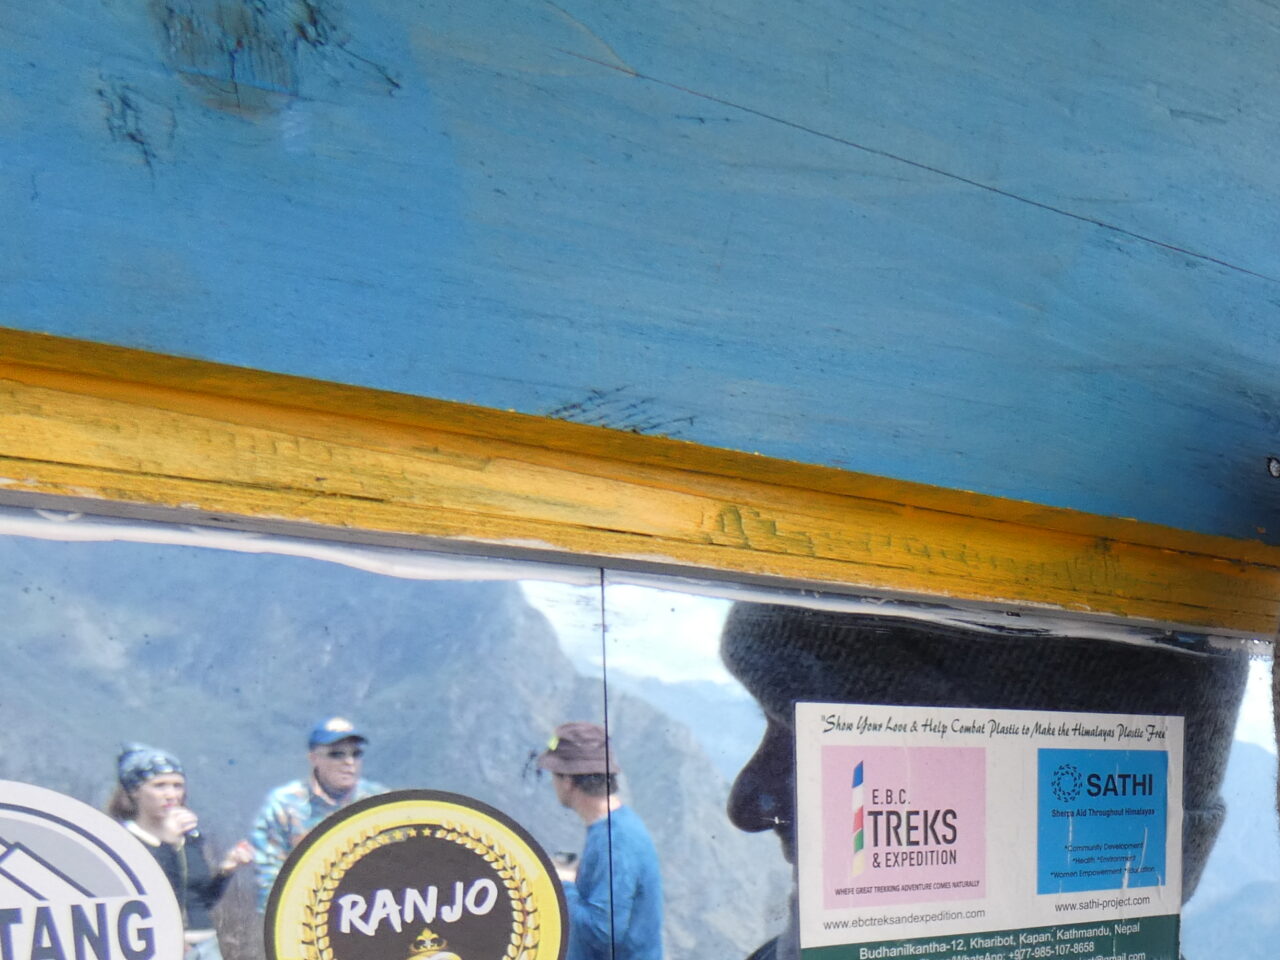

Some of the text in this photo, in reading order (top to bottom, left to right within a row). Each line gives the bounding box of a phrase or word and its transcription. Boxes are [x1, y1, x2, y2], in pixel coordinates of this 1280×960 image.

[856, 715, 882, 734] Your
[885, 715, 907, 733] Love
[910, 721, 918, 733] &
[921, 718, 948, 738] Help
[950, 718, 986, 734] Combat
[988, 719, 1019, 738] Plastic
[1022, 724, 1029, 735] to
[1030, 721, 1056, 738] Make
[1058, 722, 1069, 736] the
[1072, 723, 1114, 741] Himalayas
[1117, 723, 1143, 741] Plastic
[1086, 773, 1153, 797] SATHI
[872, 788, 911, 805] E.B.C.
[1051, 807, 1155, 819] Sherpa Aid Throughout Himalayas
[867, 809, 958, 847] TREKS
[872, 850, 957, 868] & EXPEDITION
[835, 880, 980, 896] WHERE GREAT TREKKING ADVENTURE COMES NATURALLY
[337, 878, 498, 936] RANJO
[1055, 895, 1150, 912] www.sathi-project.com
[823, 908, 986, 930] www.ebctreksandexpedition.com
[859, 922, 1140, 960] Budhanilkantha-12, Kharibot, Kapan, Kathmandu, Nepal
[1008, 941, 1094, 960] +977-985-107-8658
